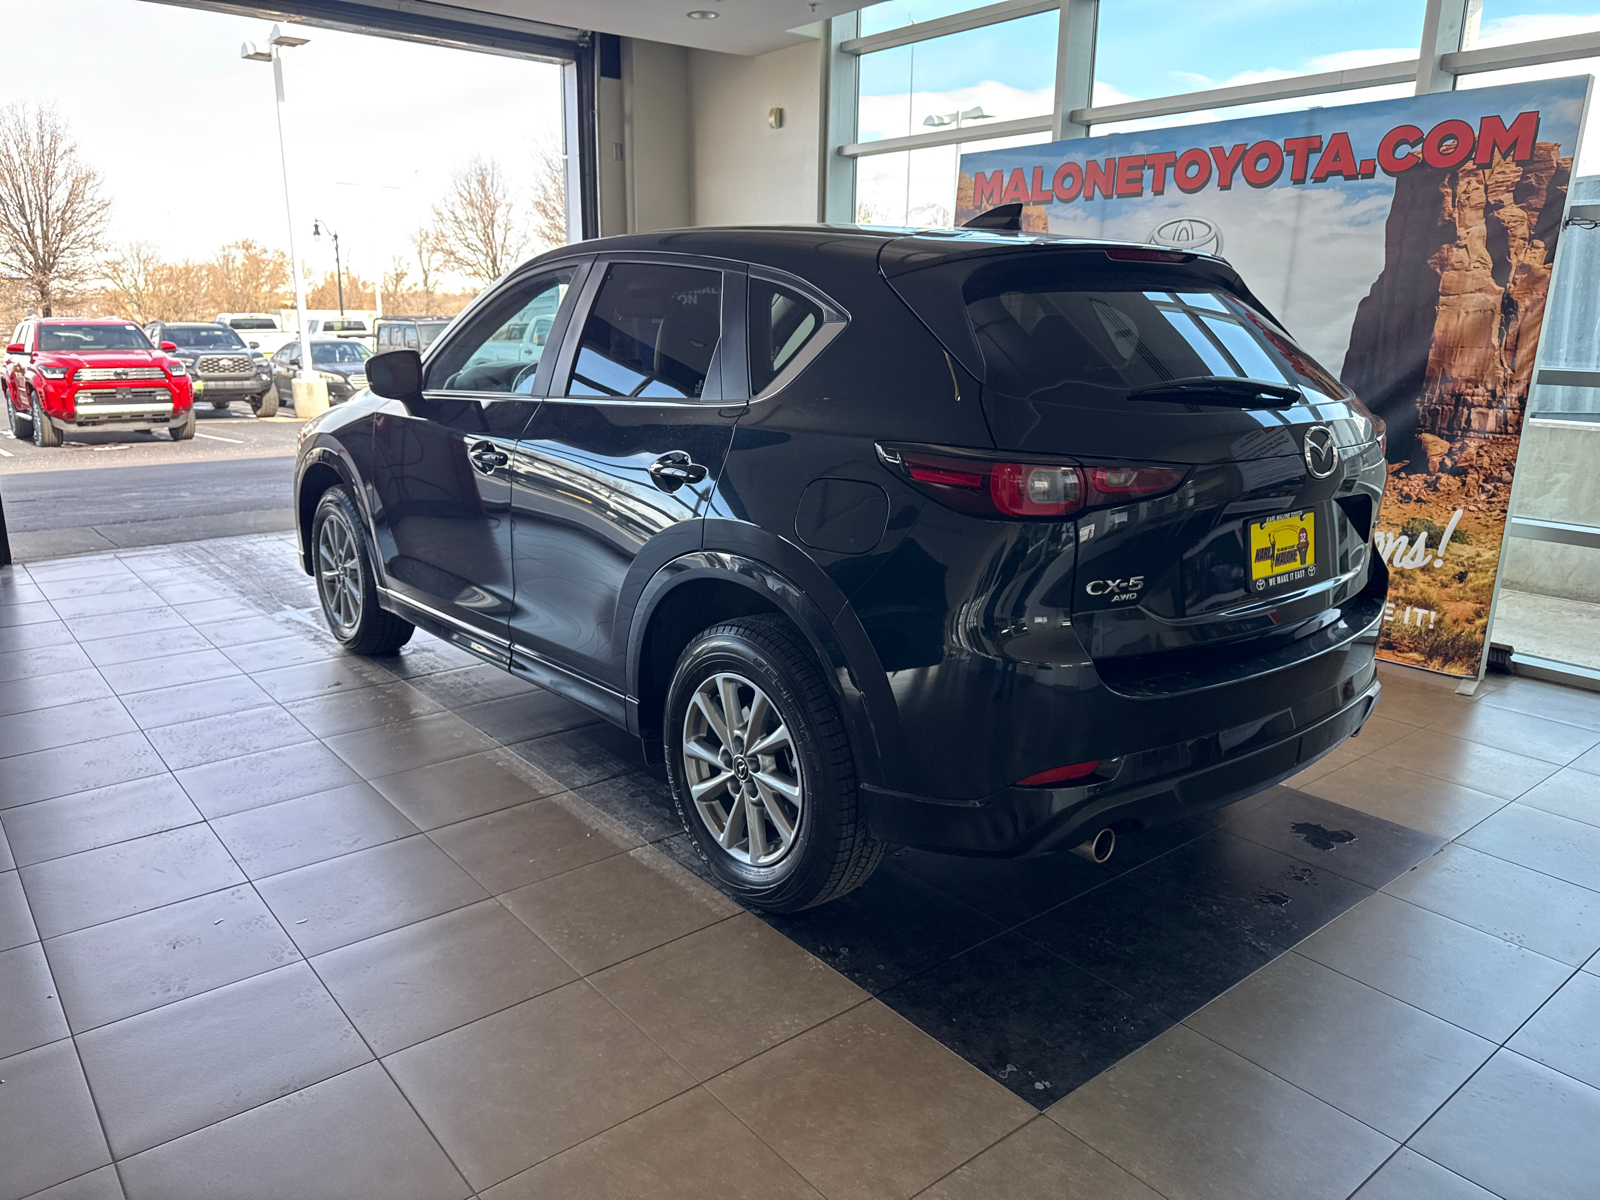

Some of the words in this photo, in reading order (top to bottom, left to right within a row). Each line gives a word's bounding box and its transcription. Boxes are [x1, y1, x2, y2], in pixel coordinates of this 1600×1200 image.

[972, 110, 1541, 209] MALONETOYOTA.COM
[1085, 575, 1145, 596] CX-5
[1268, 577, 1276, 587] WE
[1276, 573, 1289, 585] MAKE
[1289, 572, 1295, 581] IT
[1294, 570, 1305, 580] EASY
[1111, 592, 1138, 603] AWD
[1403, 606, 1436, 629] IT!
